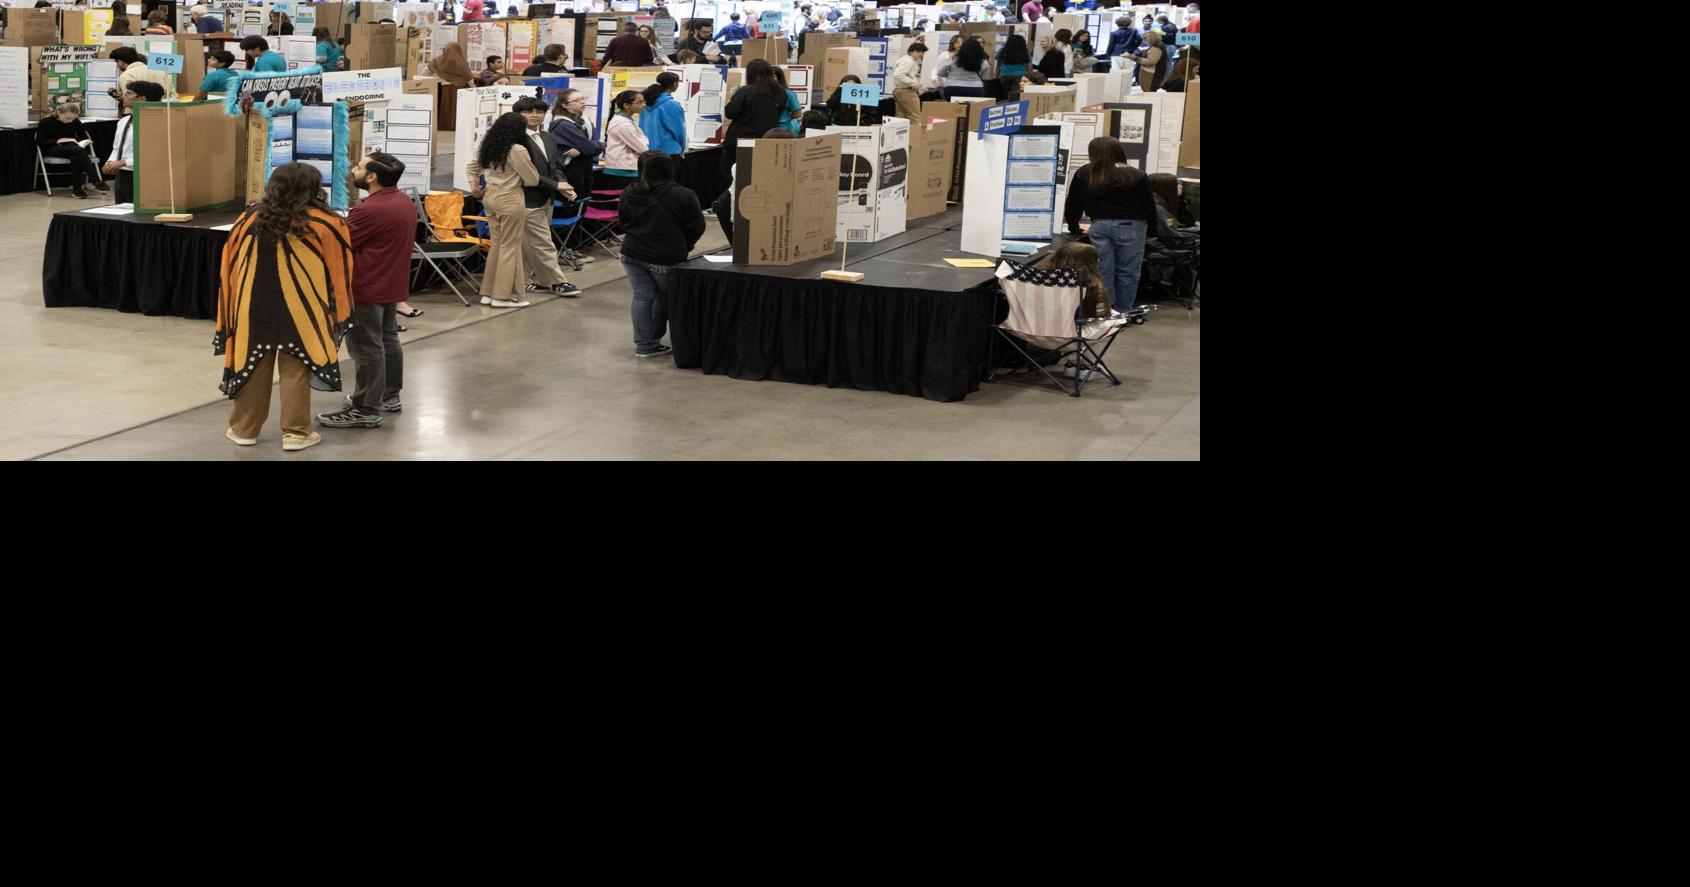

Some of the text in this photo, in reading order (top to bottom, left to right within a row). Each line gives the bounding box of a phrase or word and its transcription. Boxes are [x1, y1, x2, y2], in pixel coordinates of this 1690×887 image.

[155, 56, 175, 66] 612
[242, 79, 253, 92] CAN
[850, 88, 870, 98] 611
